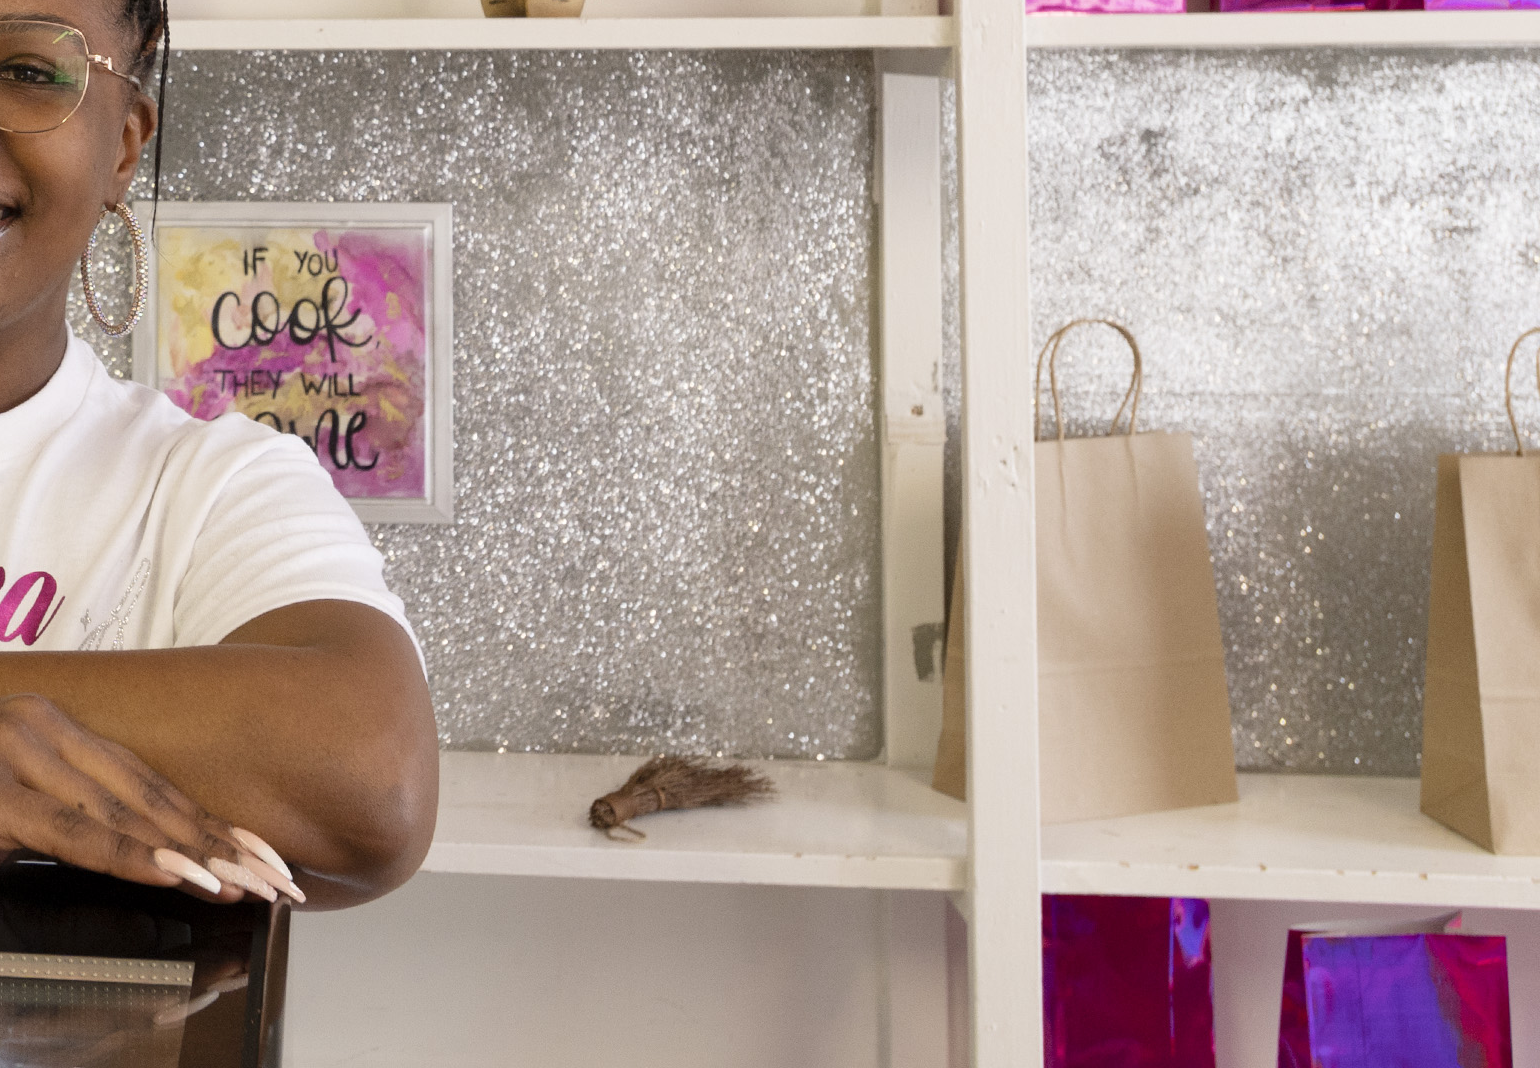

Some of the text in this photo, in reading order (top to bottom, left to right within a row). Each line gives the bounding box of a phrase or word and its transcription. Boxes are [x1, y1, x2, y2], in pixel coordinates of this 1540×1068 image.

[243, 247, 339, 277] IF YOU
[213, 370, 361, 399] THEY WILL
